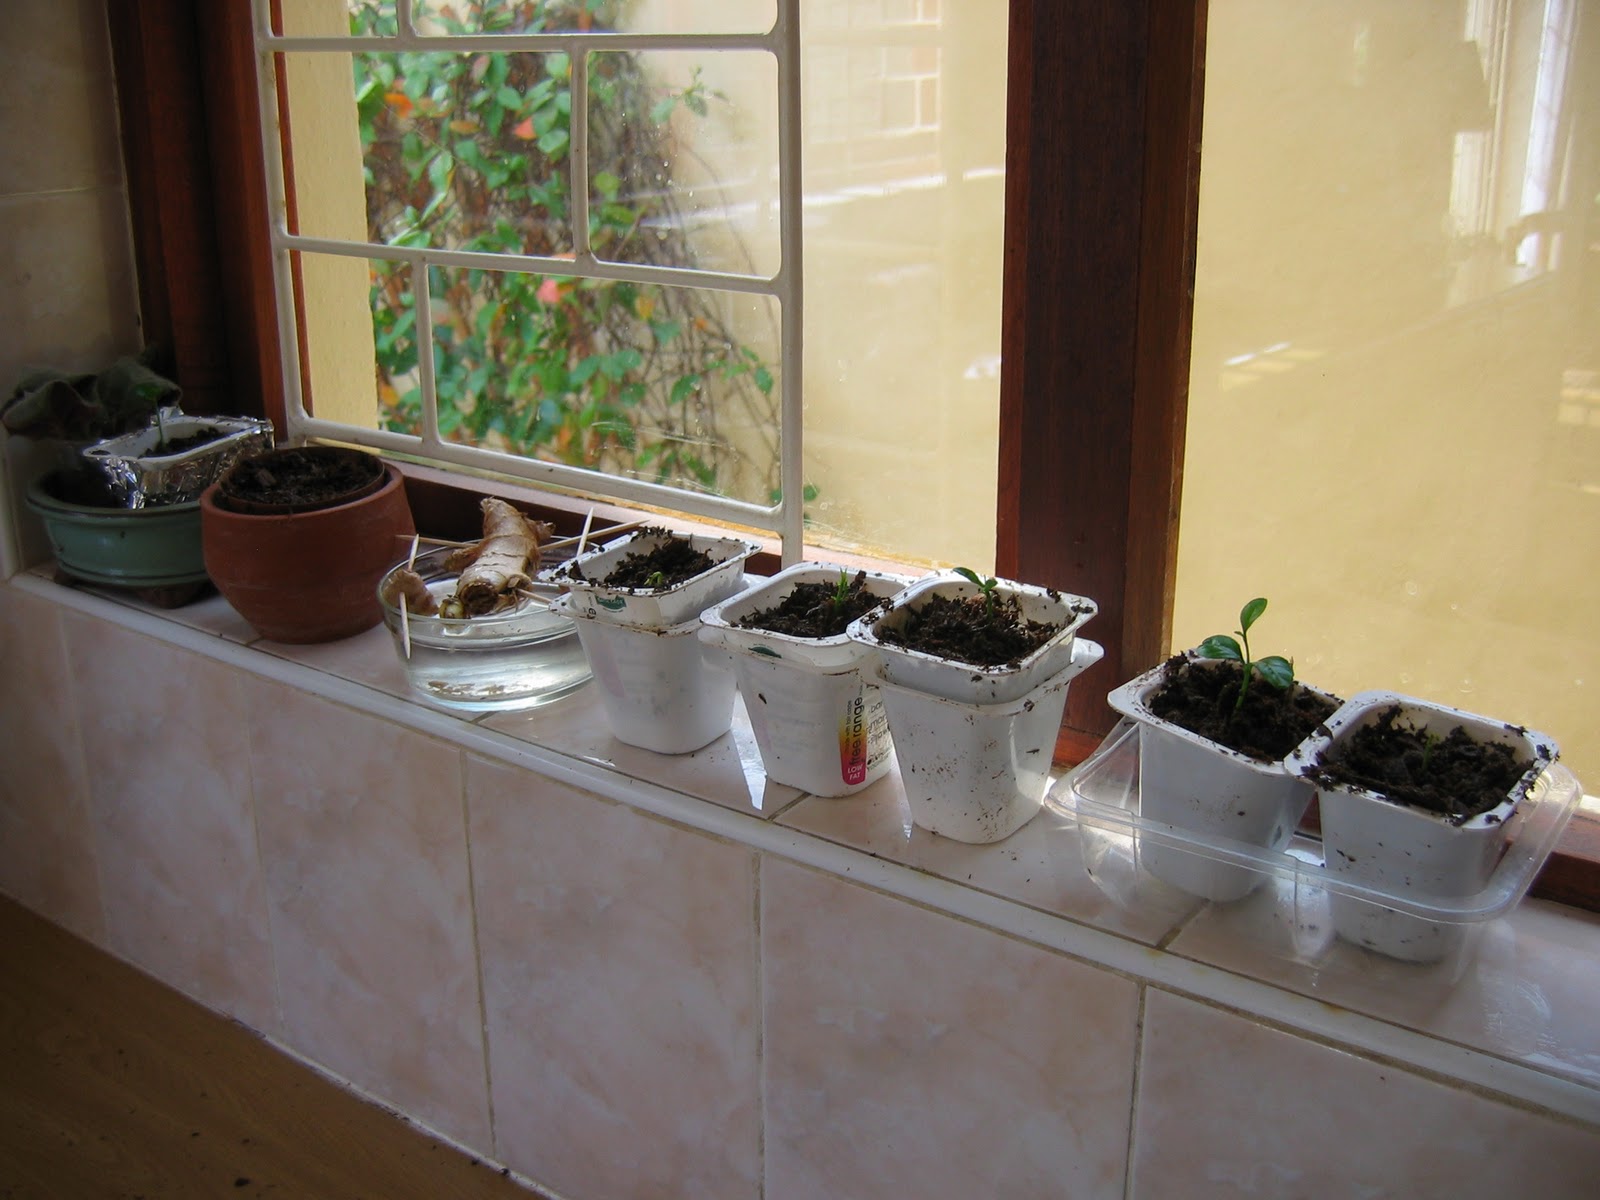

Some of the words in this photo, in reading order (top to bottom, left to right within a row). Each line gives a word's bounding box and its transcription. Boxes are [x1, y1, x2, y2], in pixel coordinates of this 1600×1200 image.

[853, 697, 865, 737] range
[849, 738, 862, 765] free
[847, 764, 862, 773] LOW
